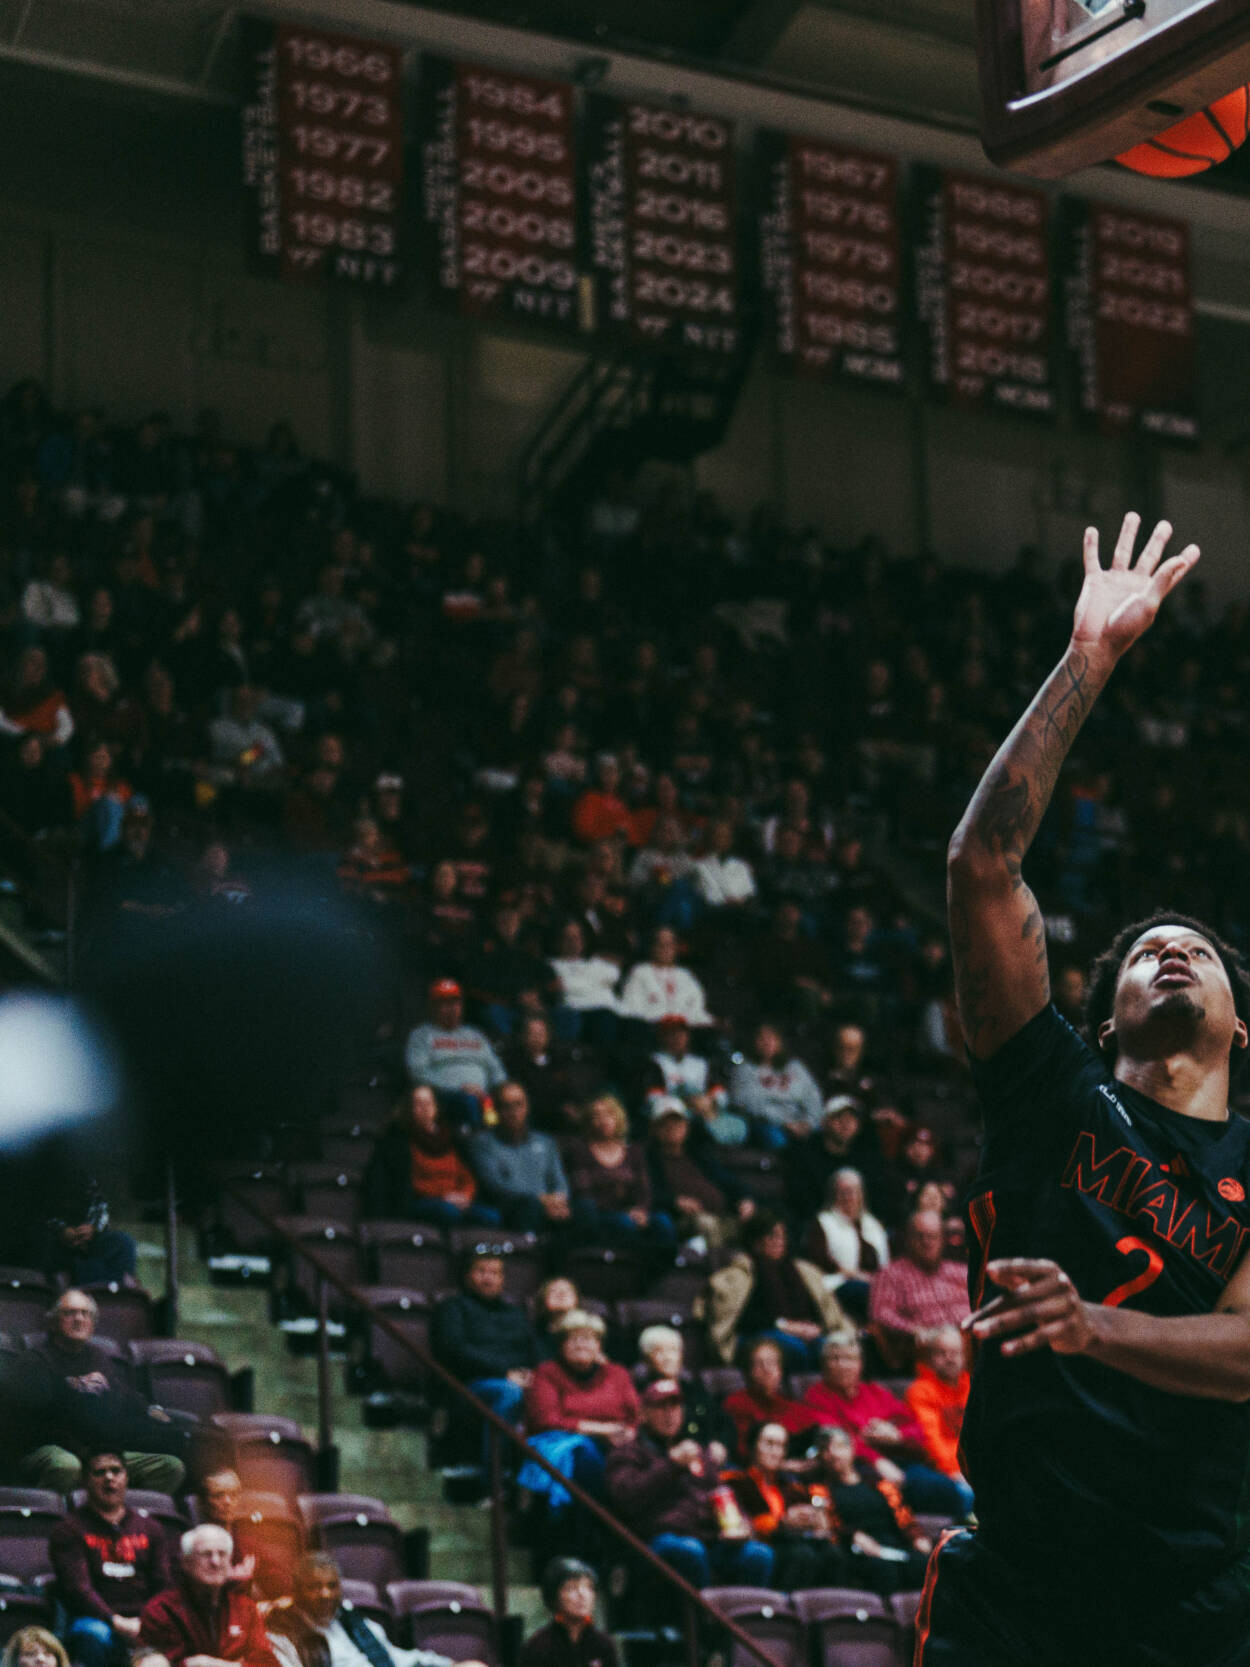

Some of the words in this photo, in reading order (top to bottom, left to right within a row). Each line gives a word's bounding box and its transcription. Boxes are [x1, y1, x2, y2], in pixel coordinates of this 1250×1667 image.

[286, 38, 392, 82] 1966
[290, 81, 390, 125] 1973
[464, 76, 564, 120] 1984
[291, 125, 390, 166] 1977
[467, 117, 566, 163] 1995
[628, 105, 727, 150] 2010
[290, 167, 394, 212] 1982
[461, 158, 574, 207] 2005
[636, 147, 723, 192] 2011
[799, 150, 888, 191] 1967
[636, 188, 729, 233] 2016
[290, 211, 394, 255] 1983
[463, 243, 575, 291] 2009
[950, 259, 1047, 303] 2007
[634, 271, 735, 315] 2024
